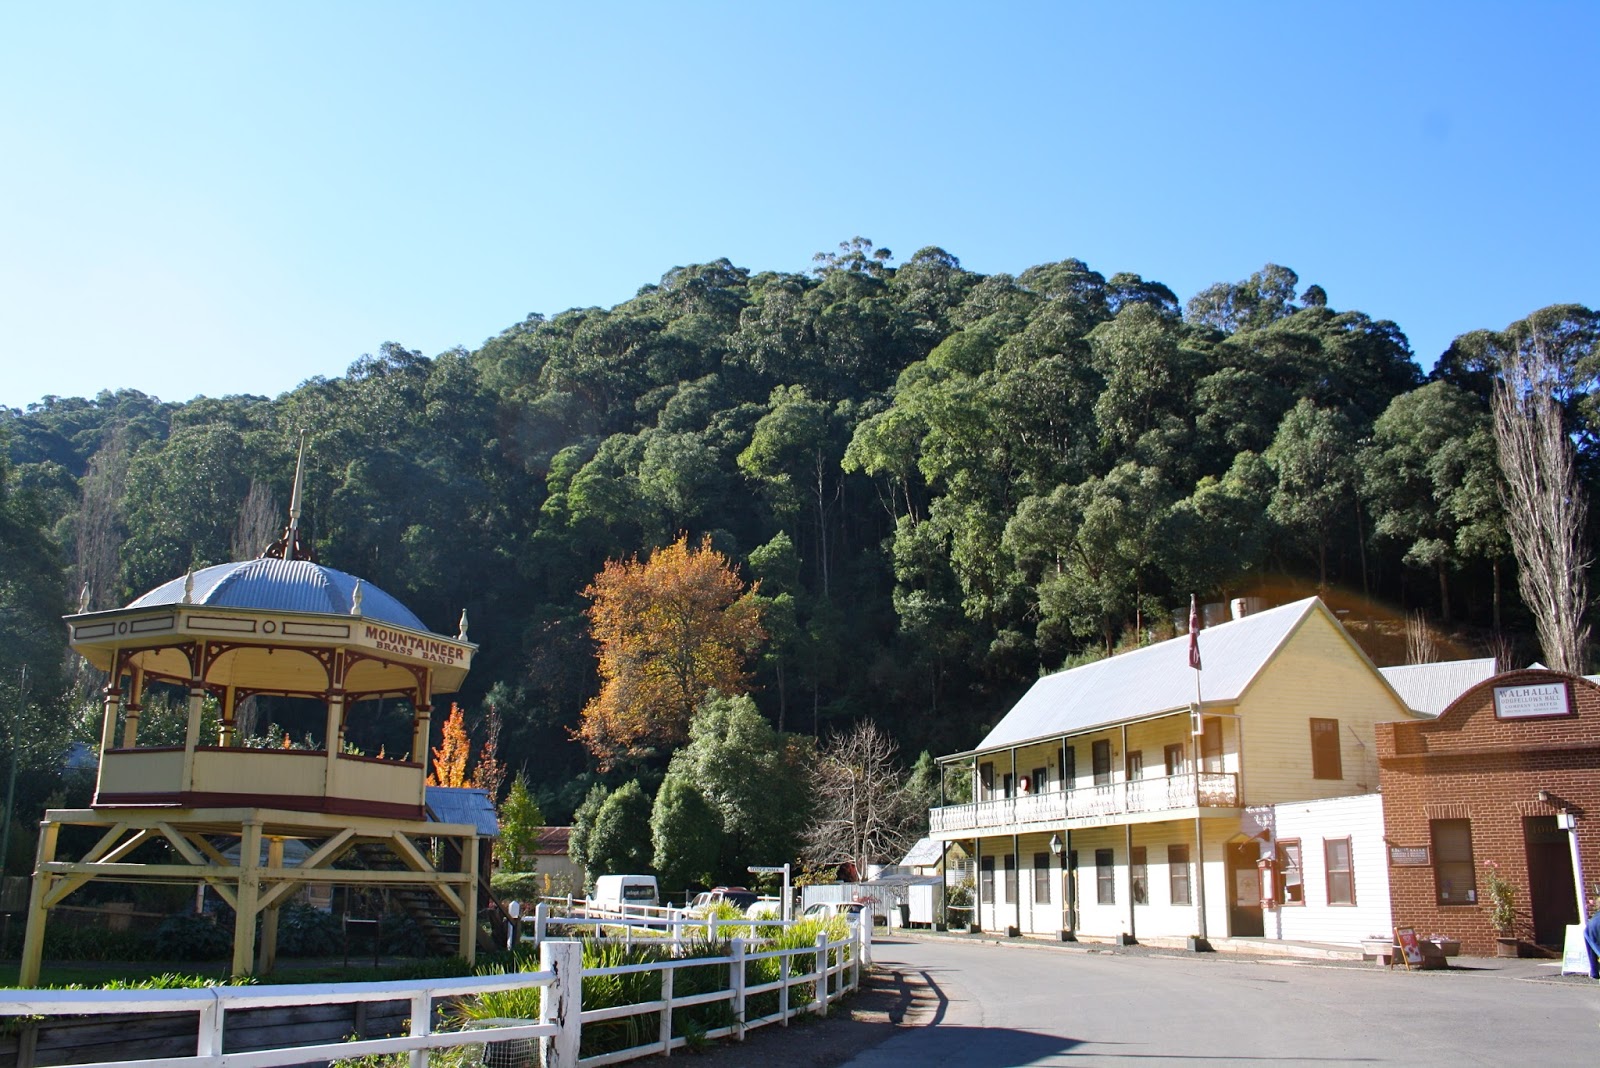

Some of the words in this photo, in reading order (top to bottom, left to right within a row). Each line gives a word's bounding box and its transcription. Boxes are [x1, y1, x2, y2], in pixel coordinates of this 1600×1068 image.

[366, 626, 464, 660] MOUNTAINEER
[376, 641, 413, 656] BRASS
[422, 651, 454, 665] BAND
[1500, 687, 1559, 698] WALHALLA
[1043, 821, 1068, 830] STAR
[1081, 818, 1117, 826] HOTEL
